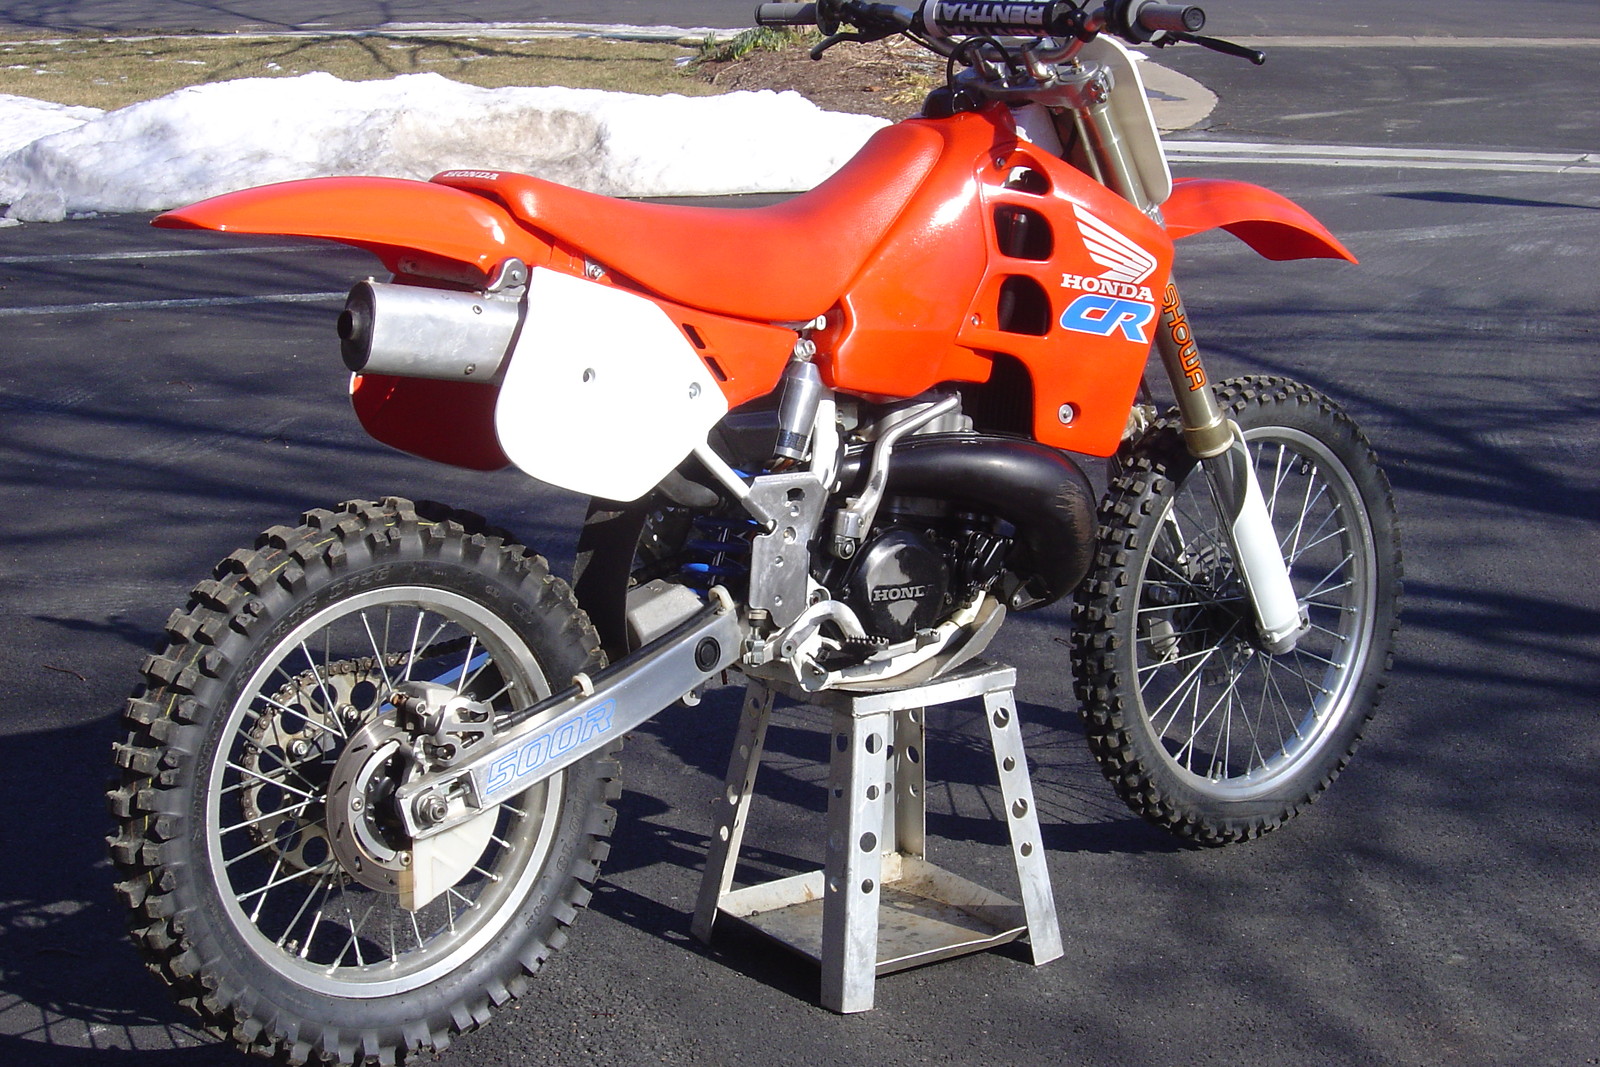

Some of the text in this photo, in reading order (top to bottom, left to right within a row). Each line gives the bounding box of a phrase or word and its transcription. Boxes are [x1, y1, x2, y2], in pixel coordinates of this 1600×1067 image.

[443, 171, 499, 180] HONDA
[1060, 273, 1155, 302] HONDA
[1059, 293, 1156, 344] CR
[1162, 283, 1207, 391] SHOWA
[873, 585, 932, 601] HOND
[486, 698, 617, 795] 500R
